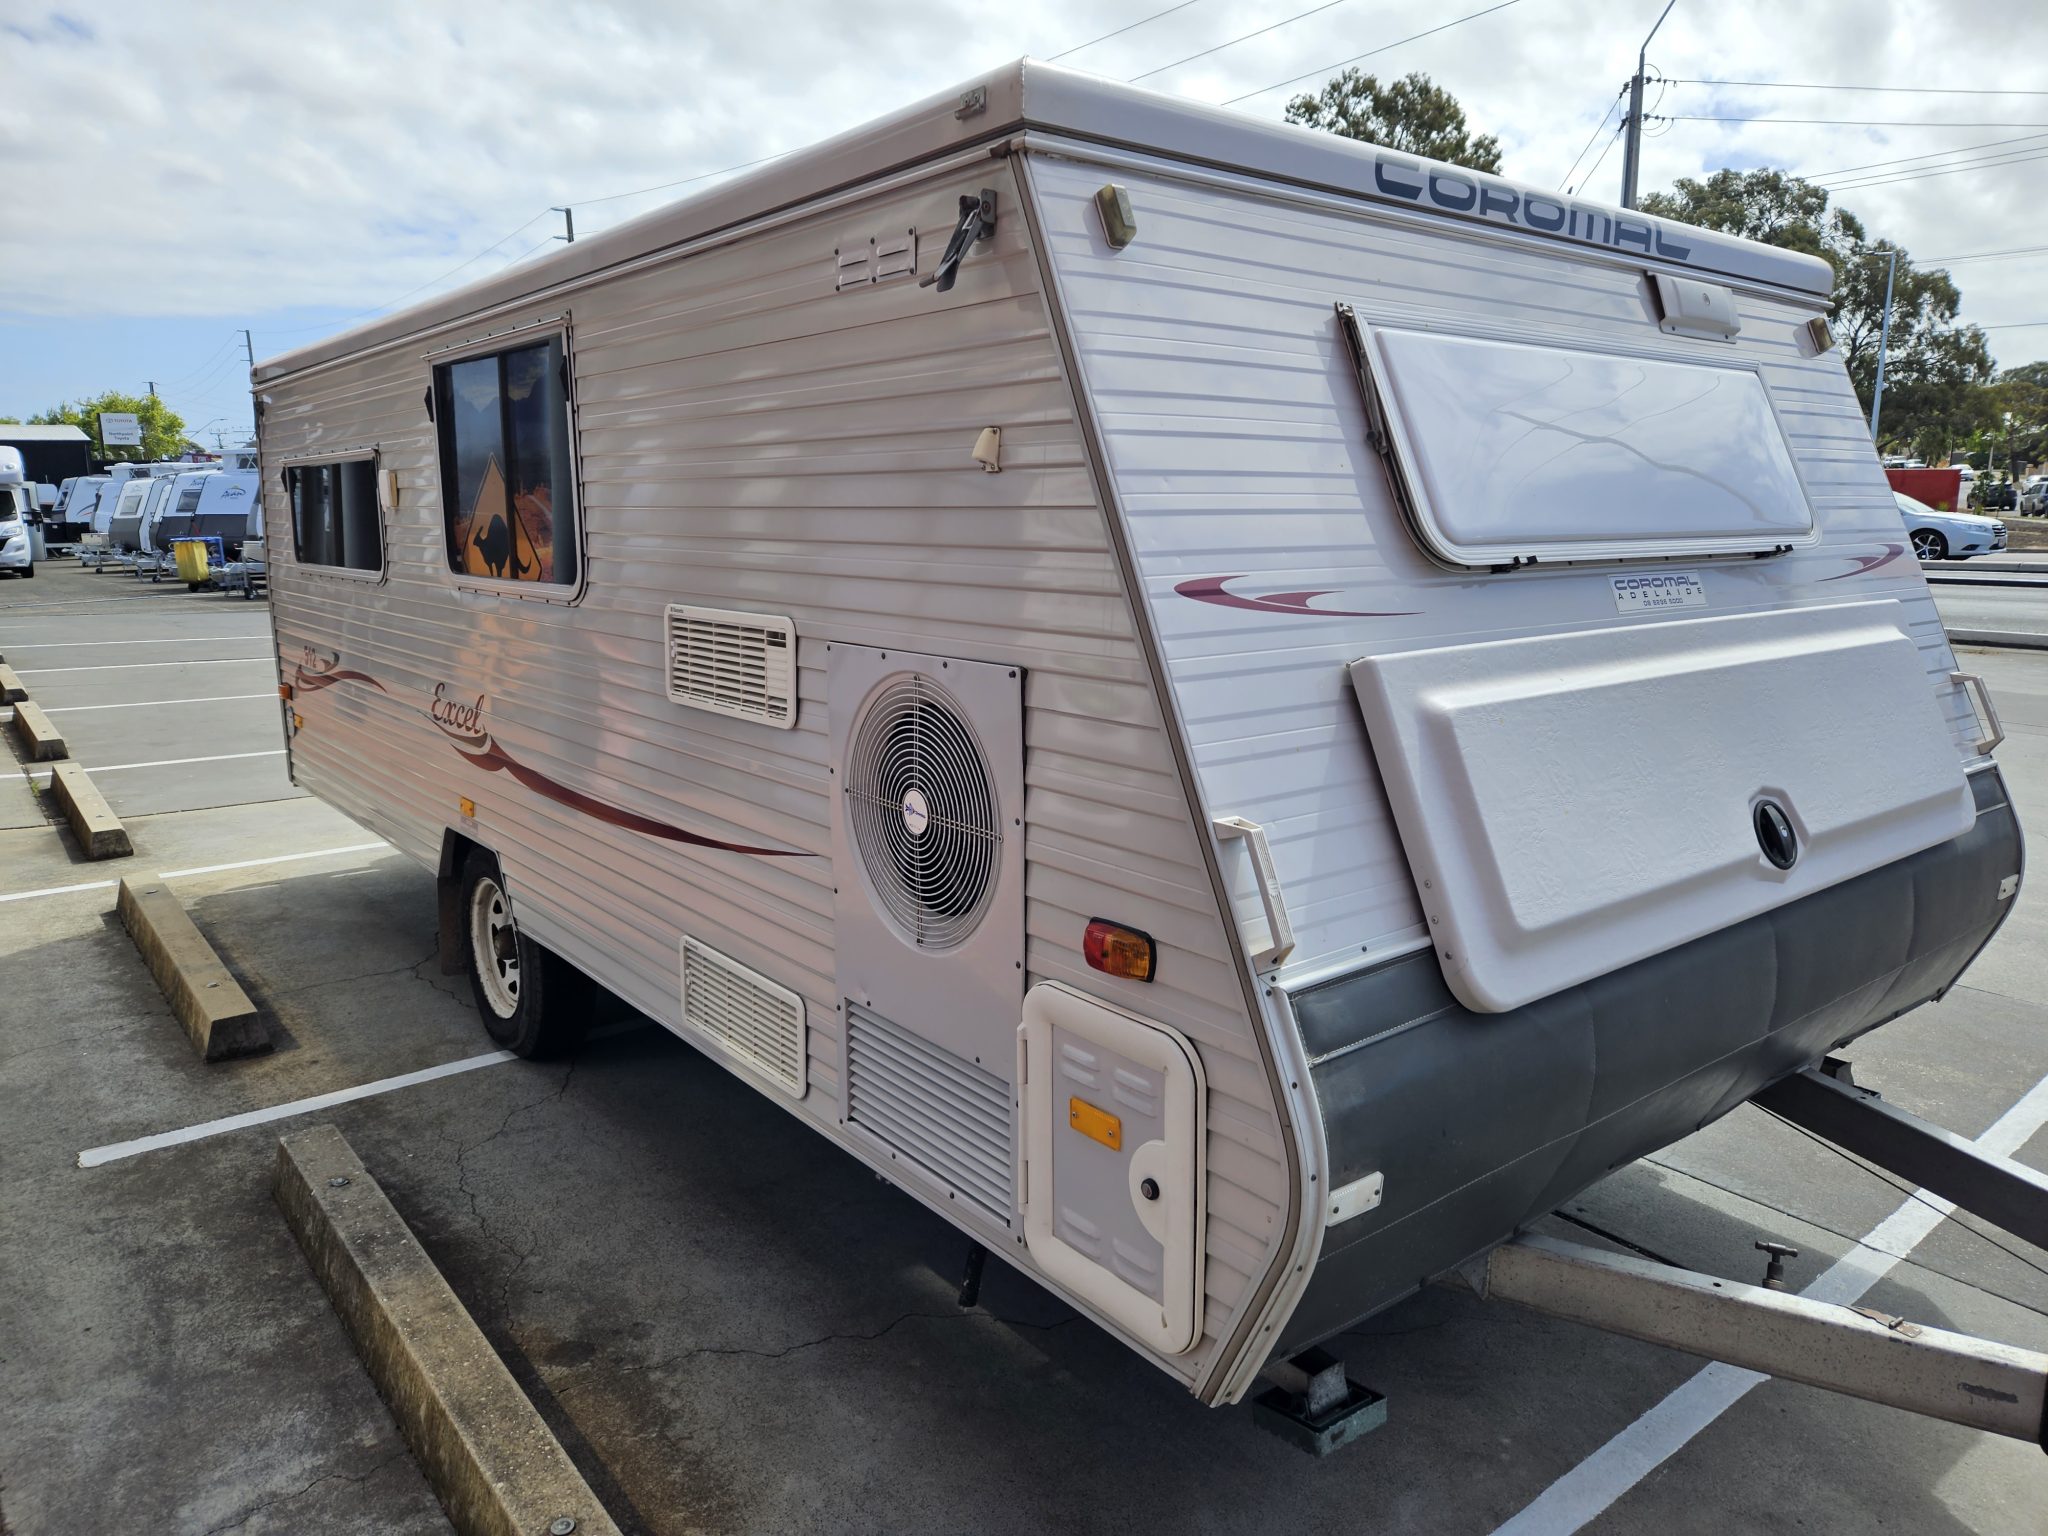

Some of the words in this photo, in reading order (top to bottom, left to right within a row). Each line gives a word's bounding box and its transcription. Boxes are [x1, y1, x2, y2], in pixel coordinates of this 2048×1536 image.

[1374, 153, 1692, 261] COROMAL
[1614, 576, 1698, 590] COROMAL
[1618, 587, 1702, 600] ADELAIDE
[431, 682, 484, 735] Excel
